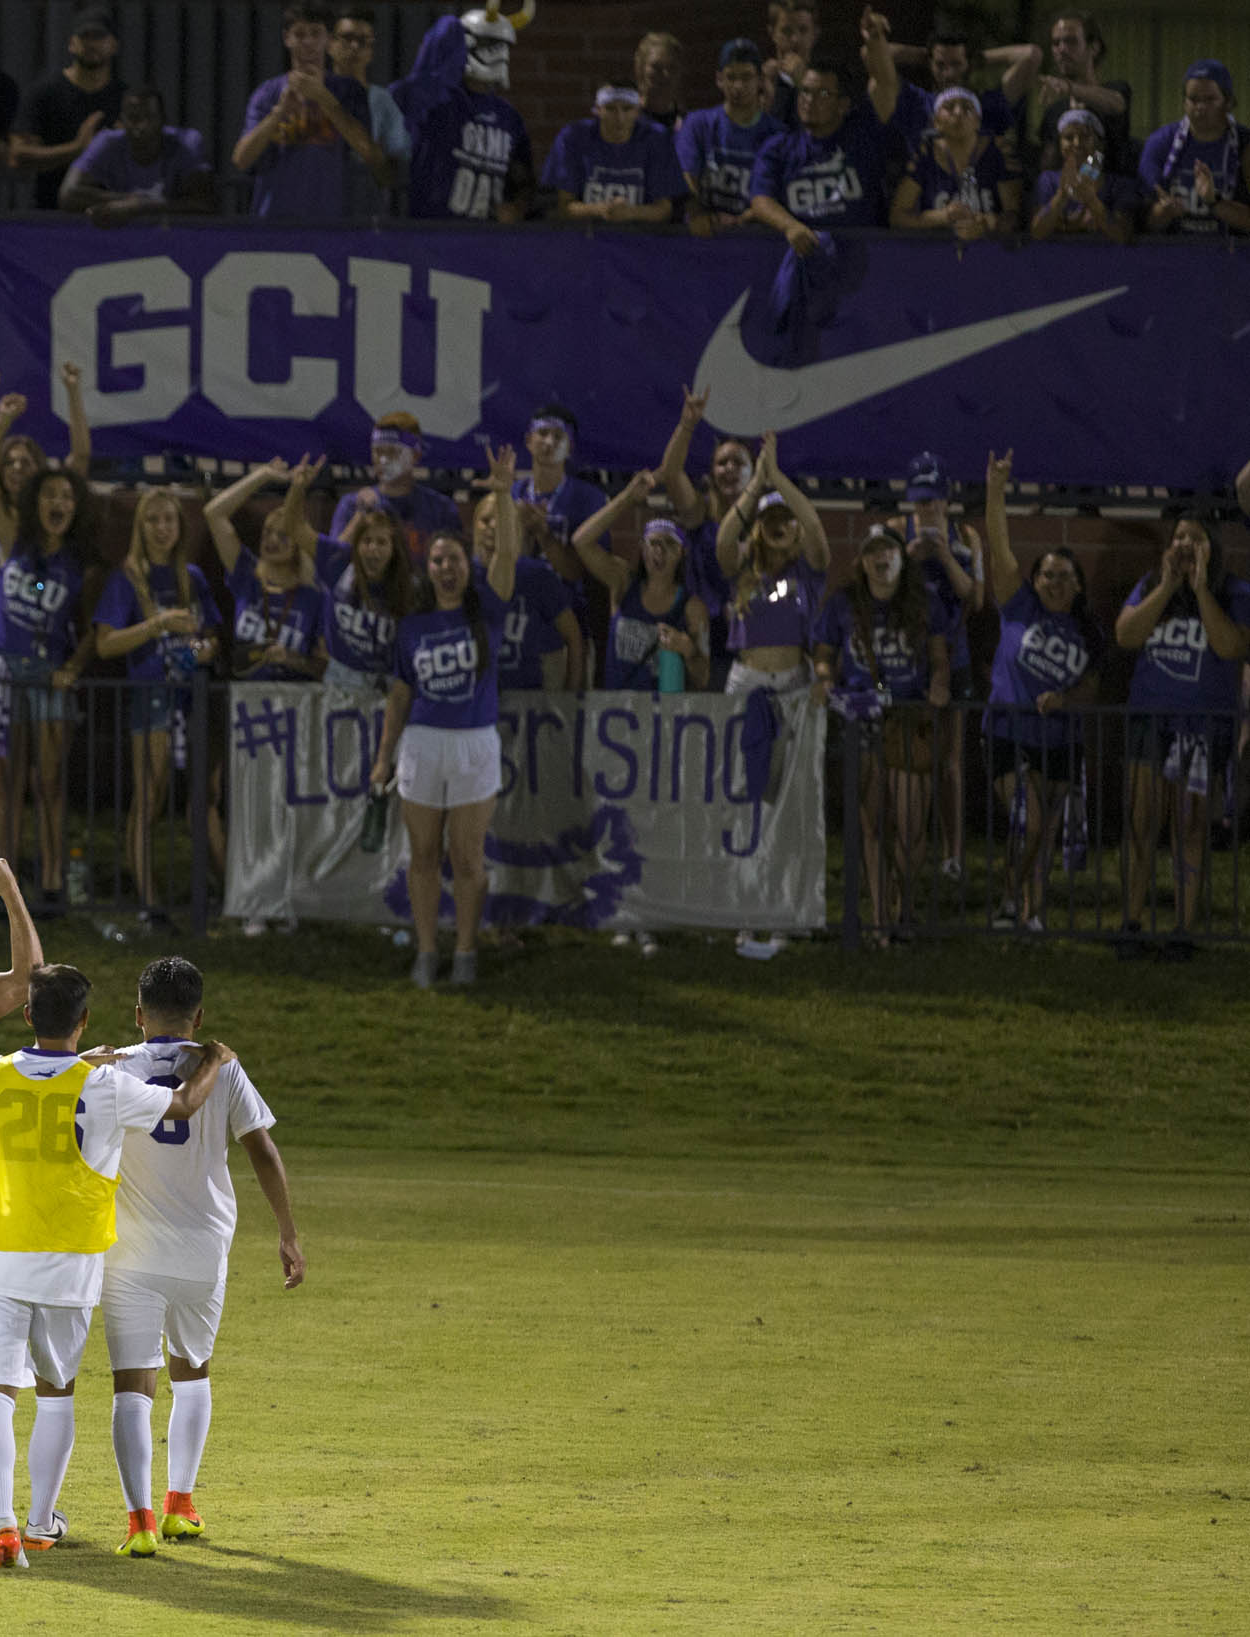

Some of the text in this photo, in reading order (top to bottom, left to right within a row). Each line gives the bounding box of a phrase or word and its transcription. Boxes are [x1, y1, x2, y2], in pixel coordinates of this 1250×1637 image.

[786, 165, 863, 215] GCU
[50, 251, 492, 441] GCU
[412, 638, 479, 682] GCU
[1021, 622, 1090, 677] GCU
